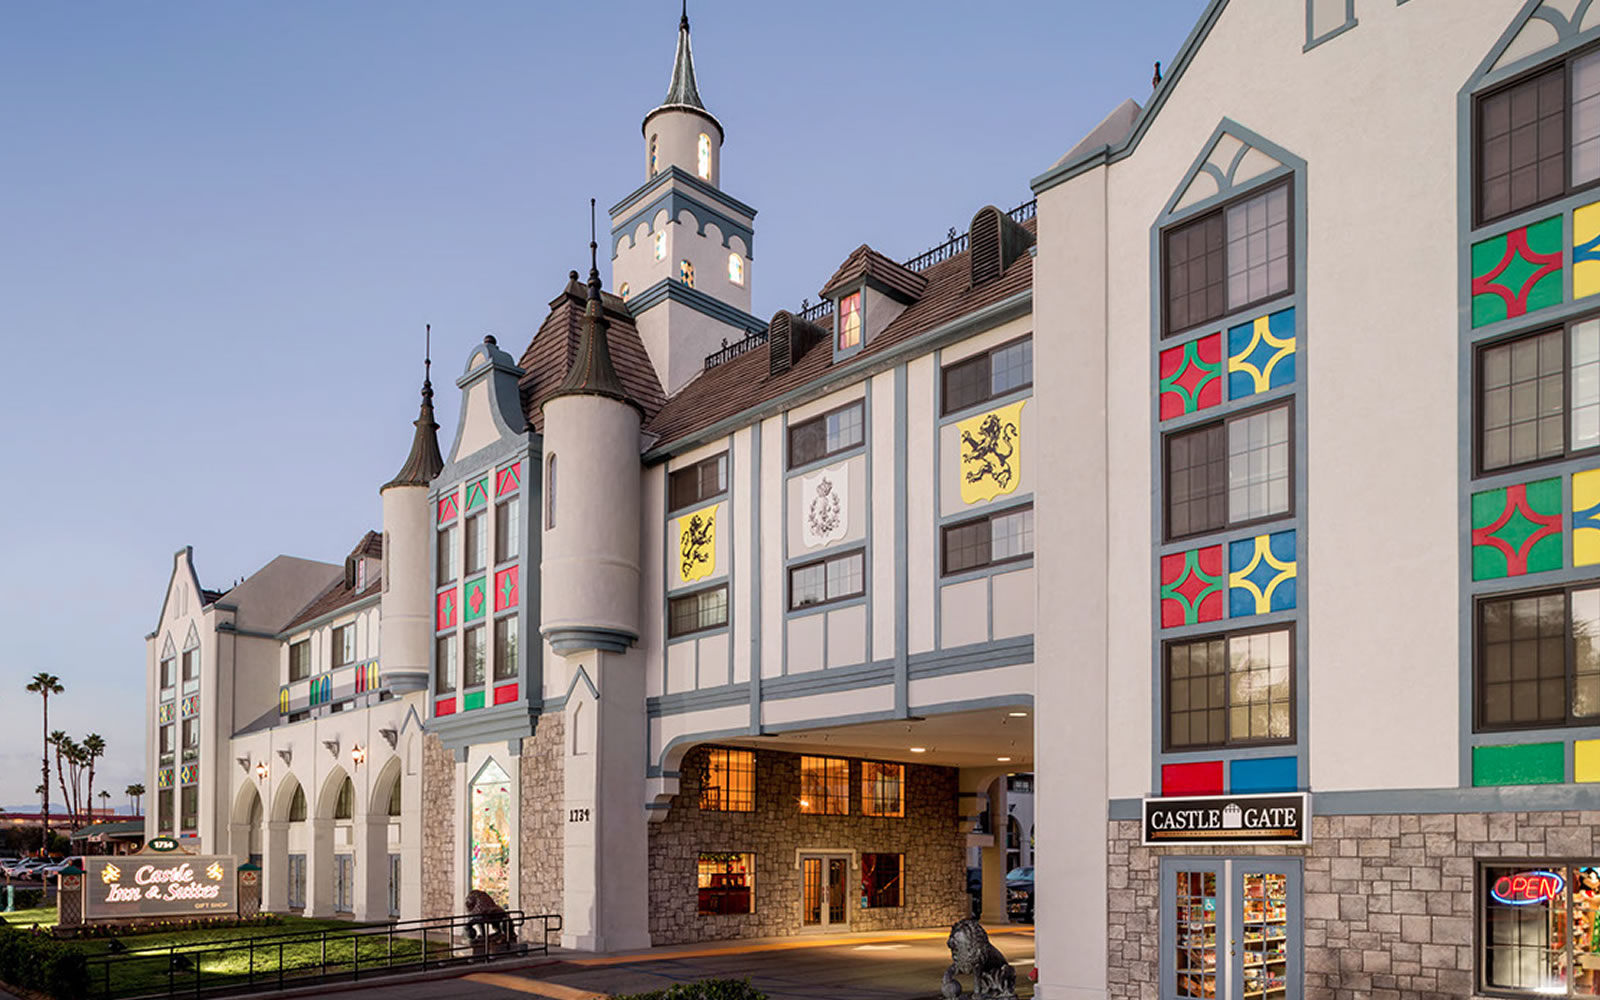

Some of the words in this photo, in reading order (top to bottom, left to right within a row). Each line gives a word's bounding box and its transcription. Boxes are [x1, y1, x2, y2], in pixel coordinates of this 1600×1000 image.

[569, 809, 590, 822] 1734
[1151, 810, 1221, 830] CASTLE
[1244, 808, 1297, 828] GATE
[153, 841, 174, 849] 1734
[135, 863, 194, 885] Castle
[105, 883, 142, 902] Inn
[145, 885, 161, 899] &
[163, 881, 220, 901] Suites
[1495, 876, 1558, 899] OPEN
